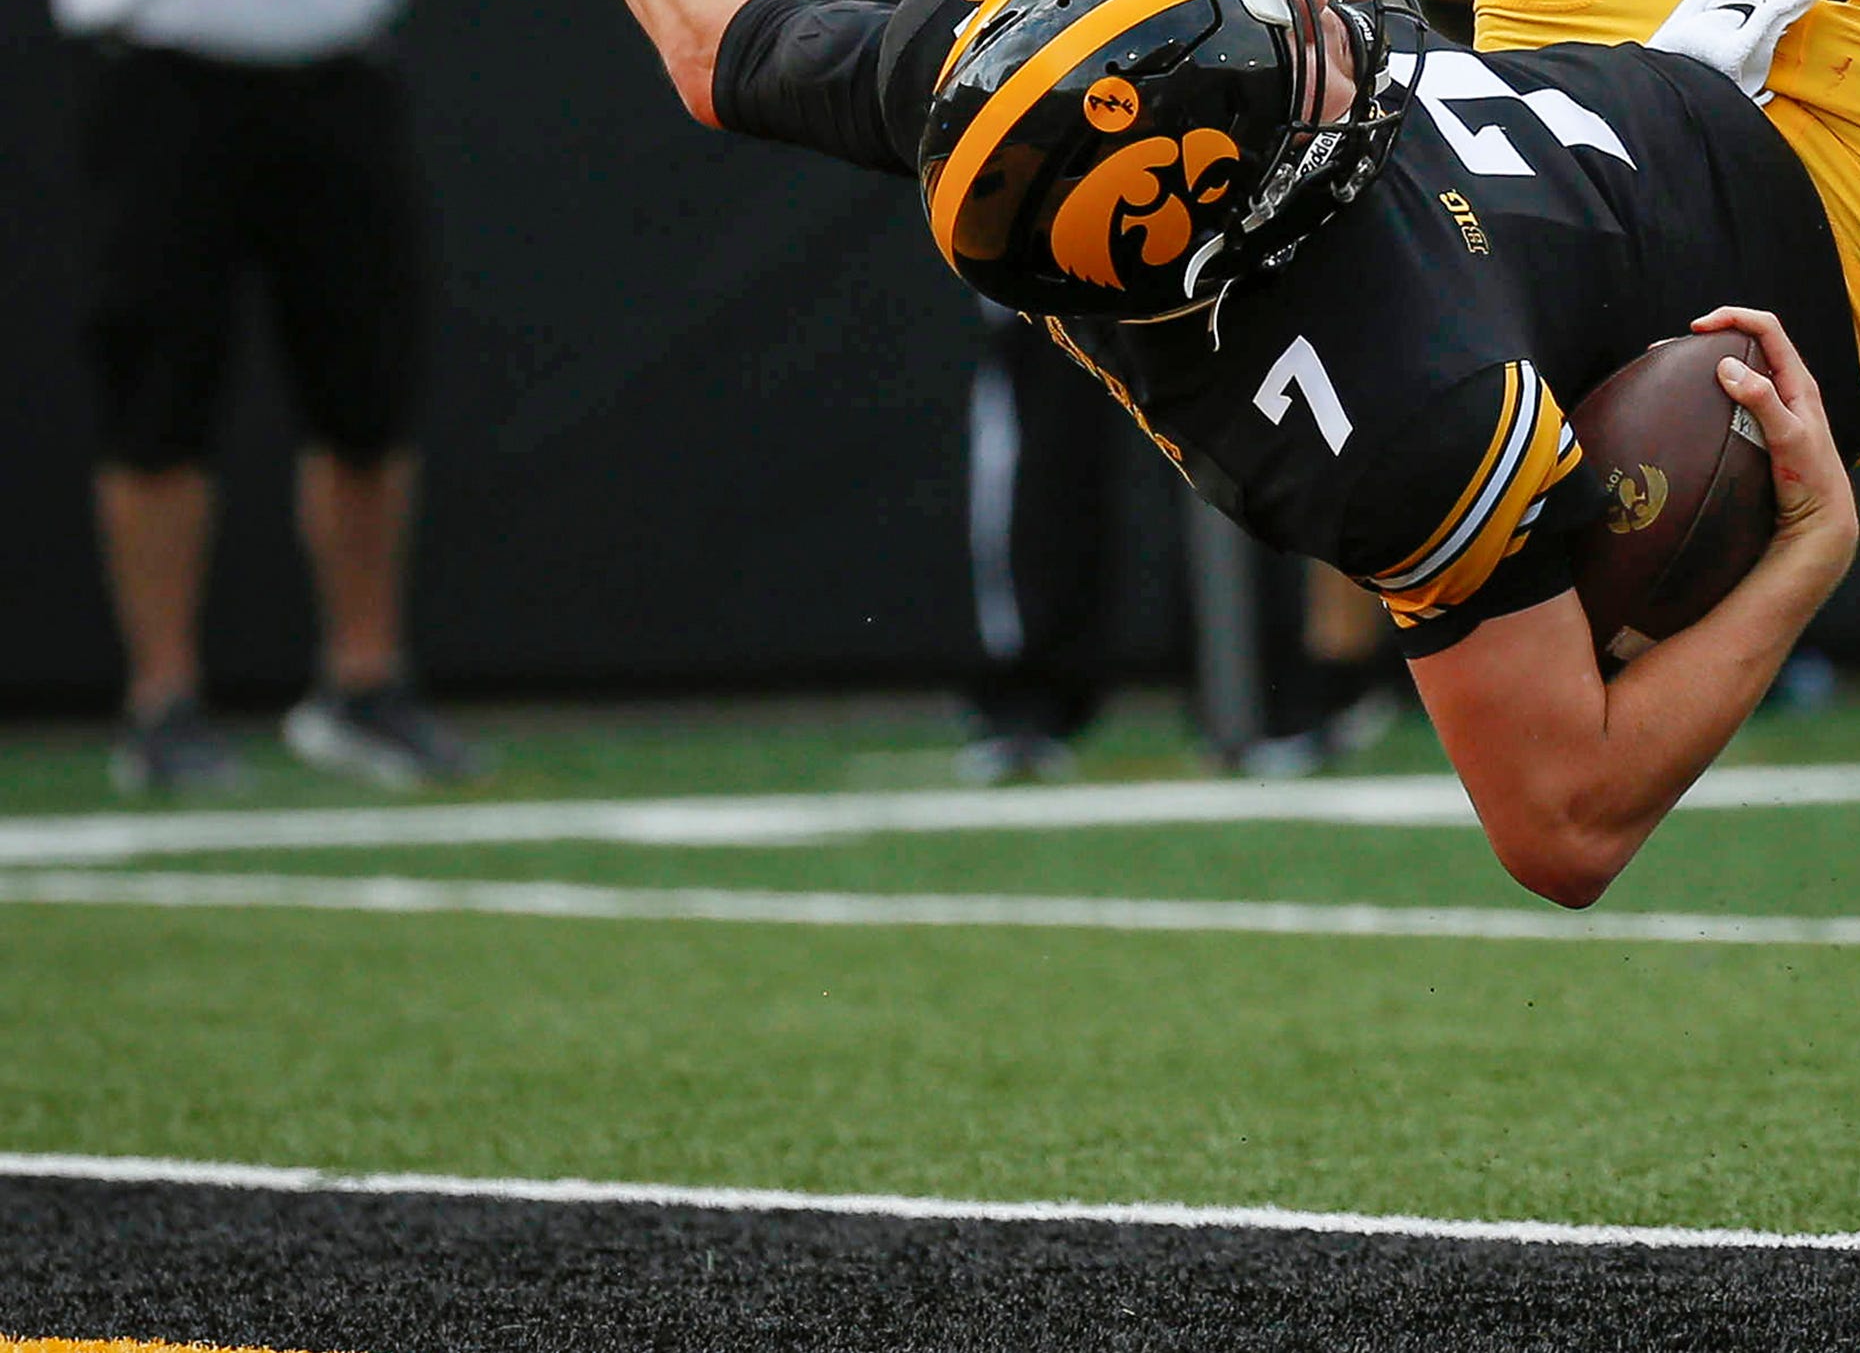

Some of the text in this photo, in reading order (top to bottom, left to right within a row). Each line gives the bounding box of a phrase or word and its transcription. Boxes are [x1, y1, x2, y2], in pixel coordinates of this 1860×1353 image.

[1087, 94, 1134, 116] ANF
[1388, 51, 1638, 175] 7
[1253, 334, 1354, 456] 7
